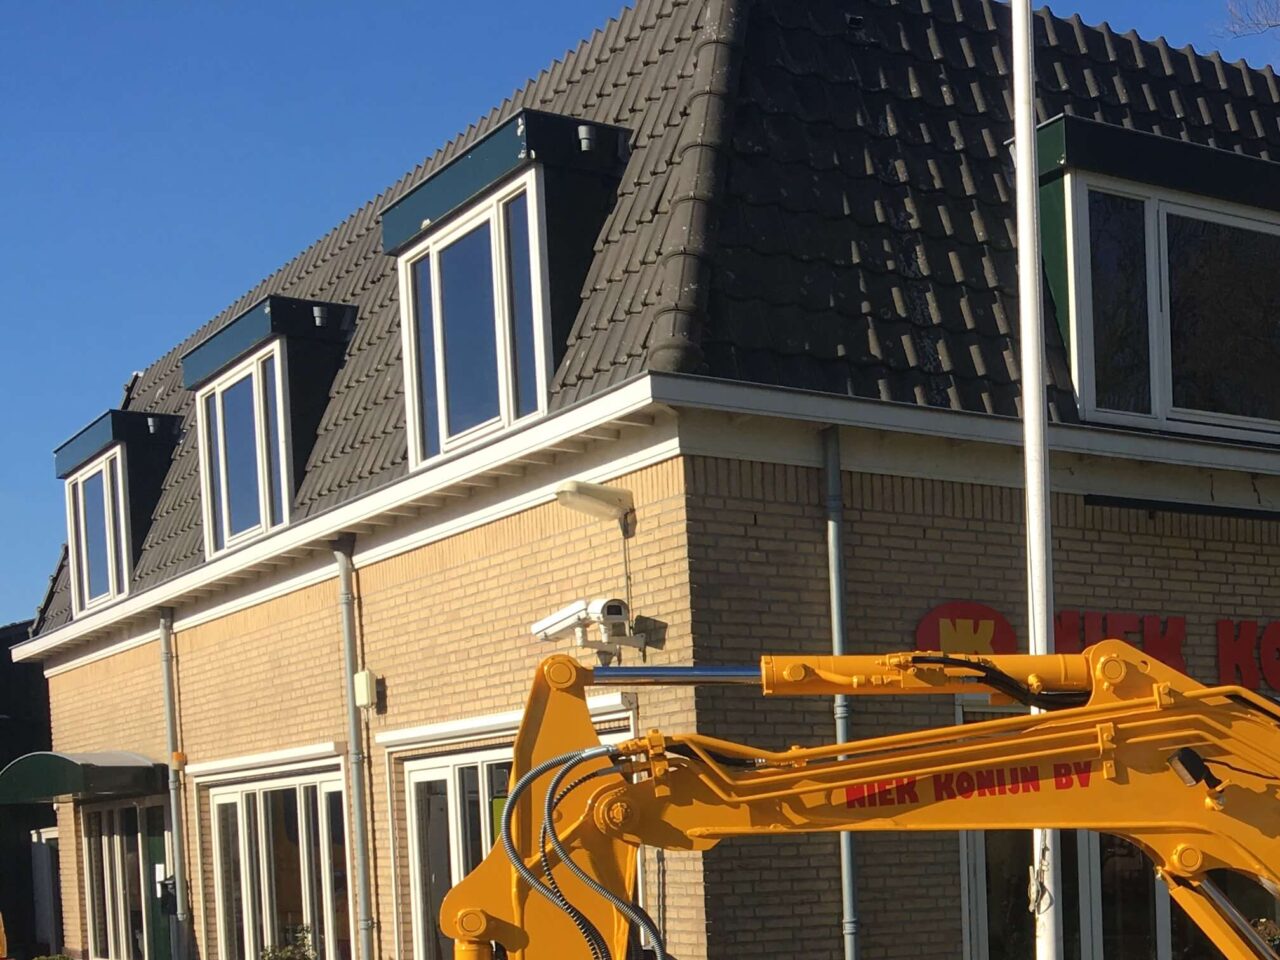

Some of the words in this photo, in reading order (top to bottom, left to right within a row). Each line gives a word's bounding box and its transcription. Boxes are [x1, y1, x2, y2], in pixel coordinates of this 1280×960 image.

[844, 775, 918, 808] NIEK
[933, 765, 1040, 801] KONIJN
[1053, 760, 1092, 790] BV
